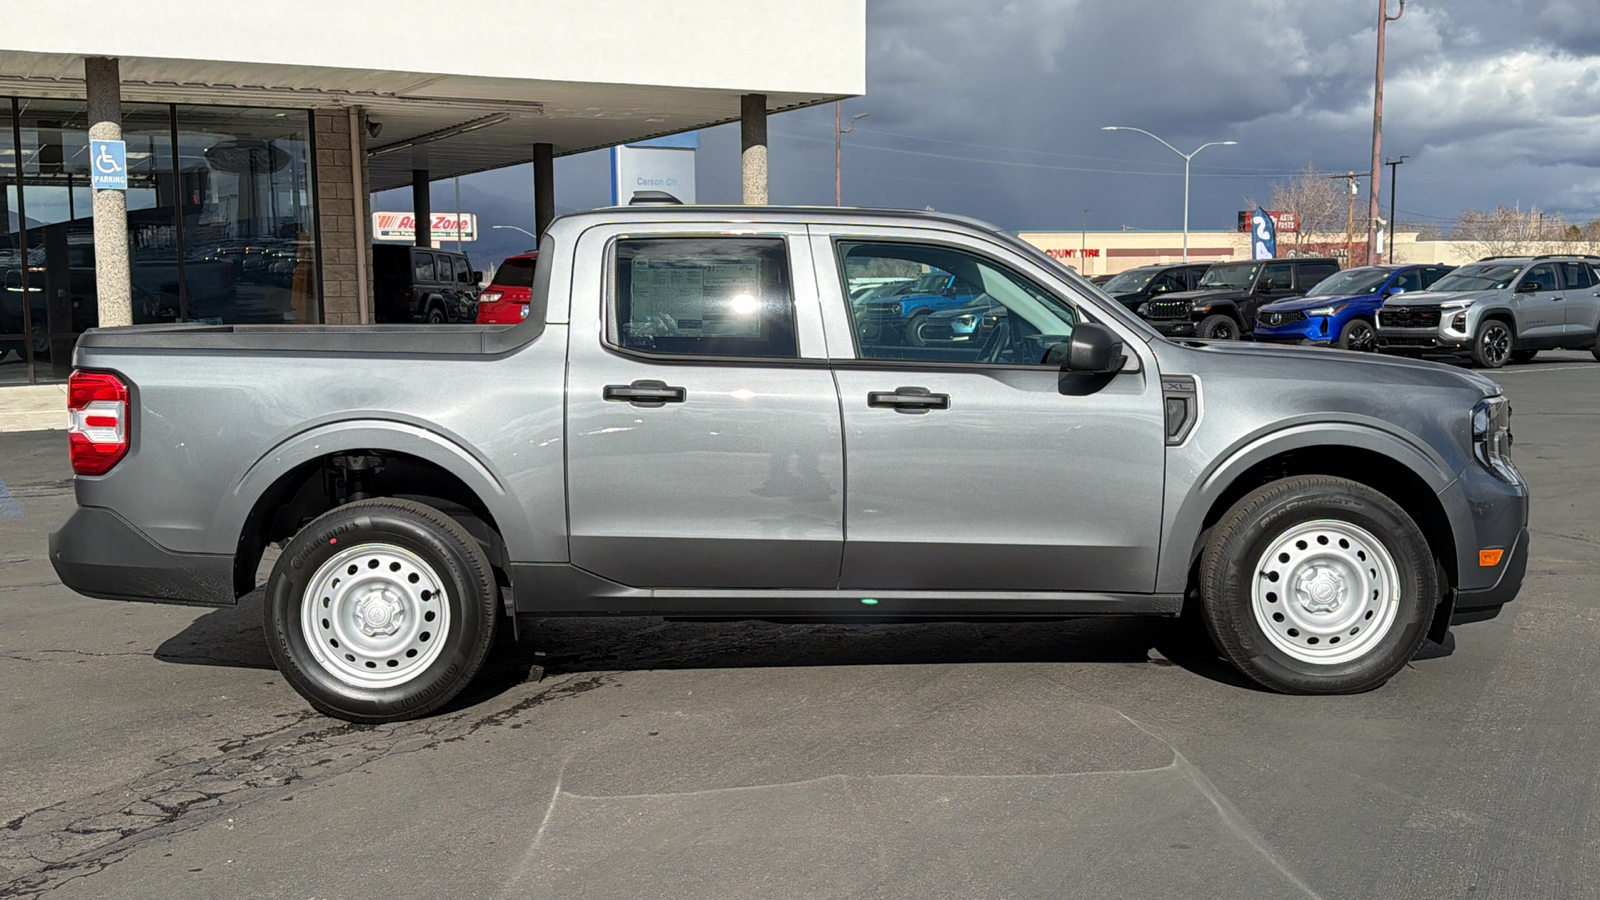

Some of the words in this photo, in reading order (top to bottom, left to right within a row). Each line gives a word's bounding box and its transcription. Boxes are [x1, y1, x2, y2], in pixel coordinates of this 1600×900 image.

[95, 176, 124, 184] PARKING
[637, 177, 664, 187] Carson
[1079, 249, 1099, 258] TIRE
